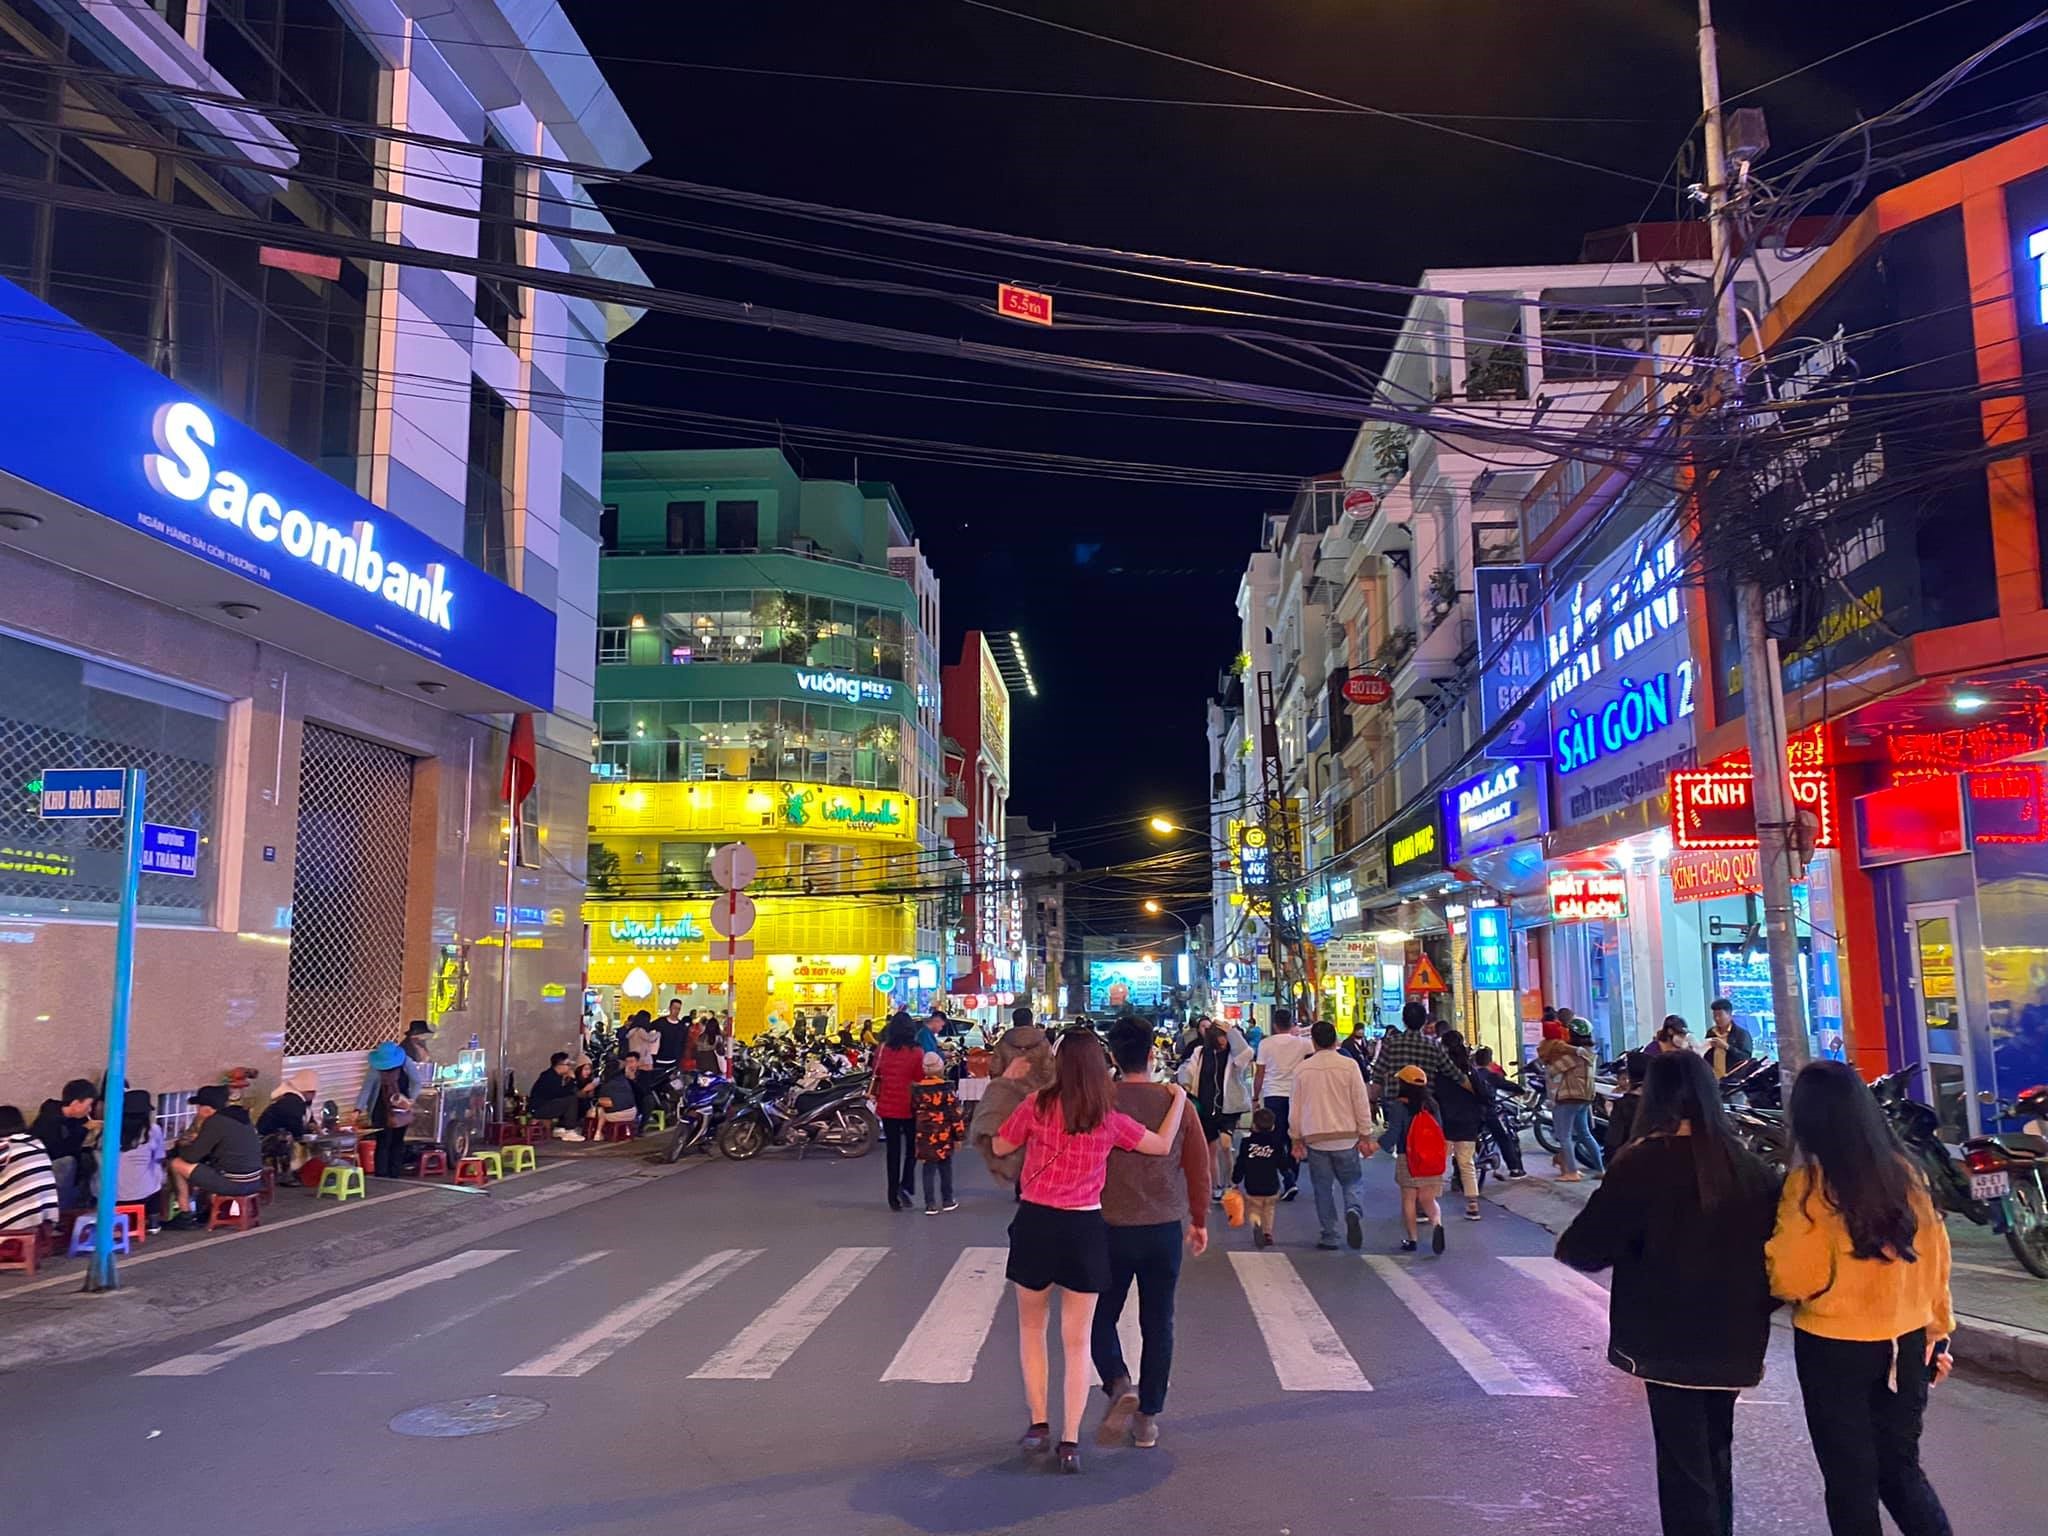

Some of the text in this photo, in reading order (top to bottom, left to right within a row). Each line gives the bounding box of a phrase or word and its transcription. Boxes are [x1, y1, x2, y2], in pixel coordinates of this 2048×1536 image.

[1009, 295, 1041, 314] 5.5m
[144, 402, 456, 631] Sacombank
[1490, 574, 1529, 609] MẮT
[1500, 645, 1530, 677] SÀI
[1350, 681, 1385, 695] HOTEL
[1558, 658, 1695, 772] SÀI GÒN 2
[1509, 719, 1528, 746] 2
[44, 785, 121, 810] KHU HÒA BÌNH
[1459, 765, 1520, 814] DALAT
[1690, 774, 1746, 806] KÍNH
[155, 850, 181, 870] THÁNG
[1673, 860, 1698, 890] KÍNH
[1700, 853, 1730, 886] CHÀO
[610, 911, 704, 940] Windmills
